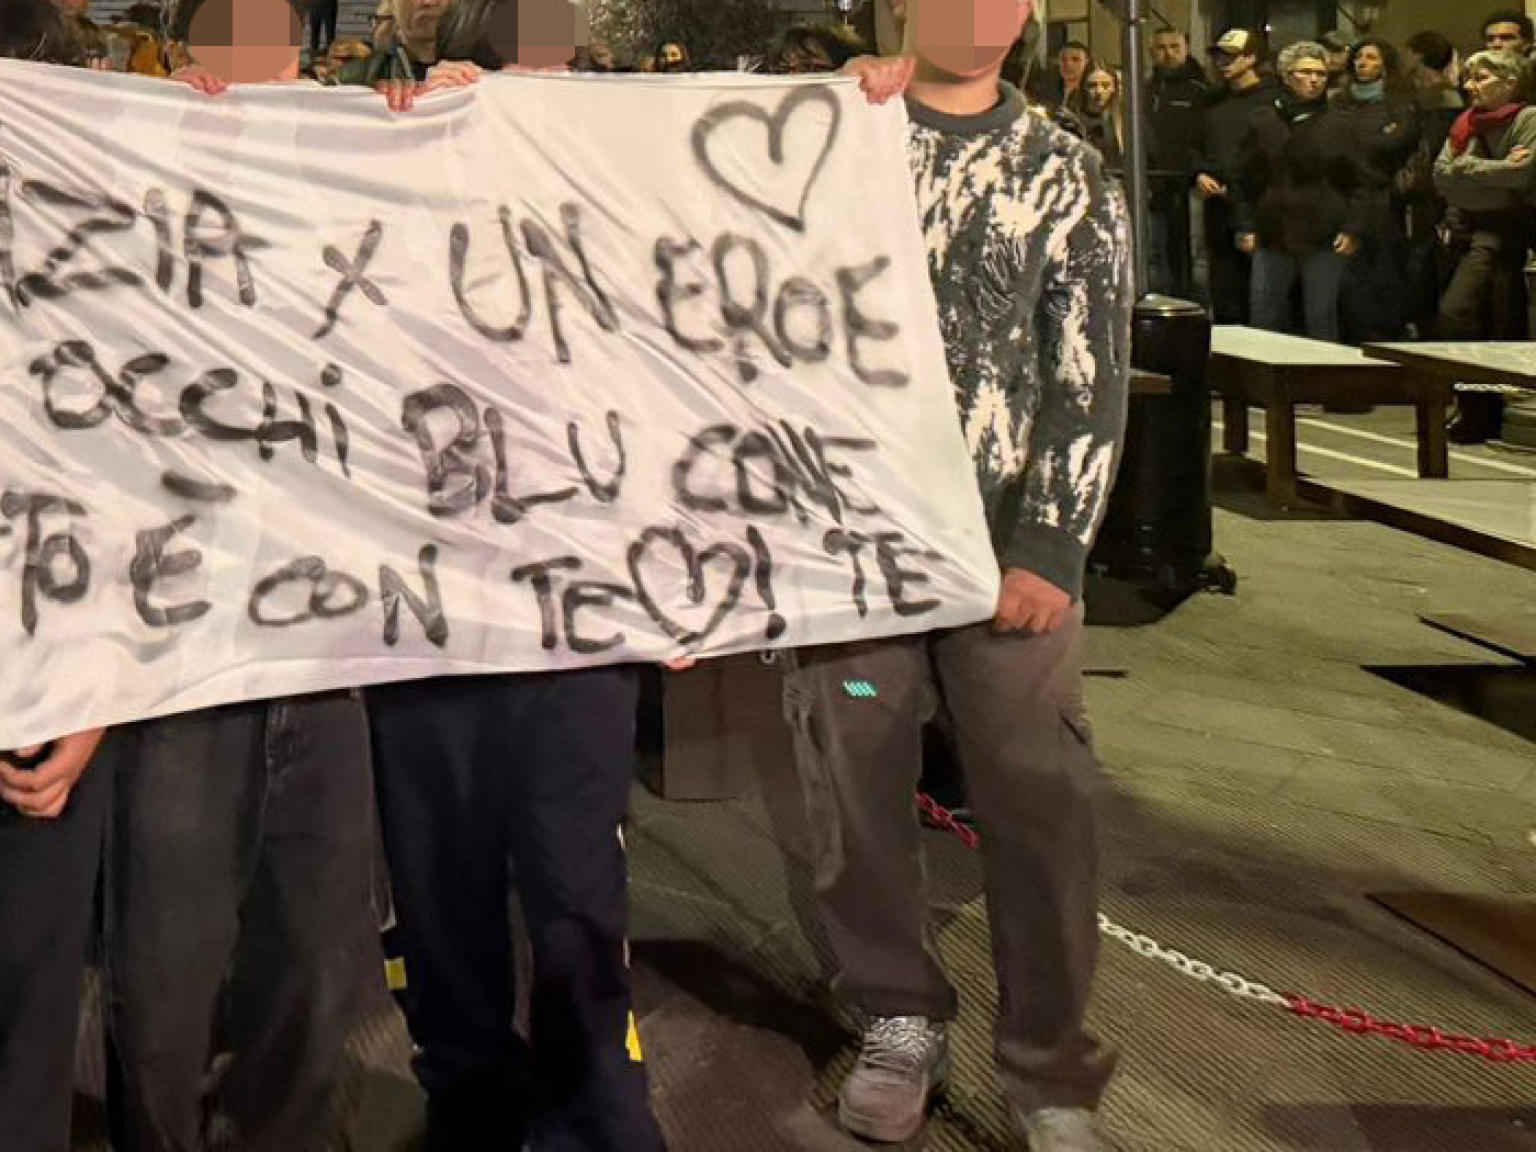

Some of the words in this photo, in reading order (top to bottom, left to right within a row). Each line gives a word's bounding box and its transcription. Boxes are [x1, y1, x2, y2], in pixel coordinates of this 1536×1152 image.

[449, 203, 622, 363] UN
[654, 231, 911, 388] EROE
[403, 383, 628, 525] BLU
[248, 543, 449, 647] CON
[823, 526, 948, 620] TE
